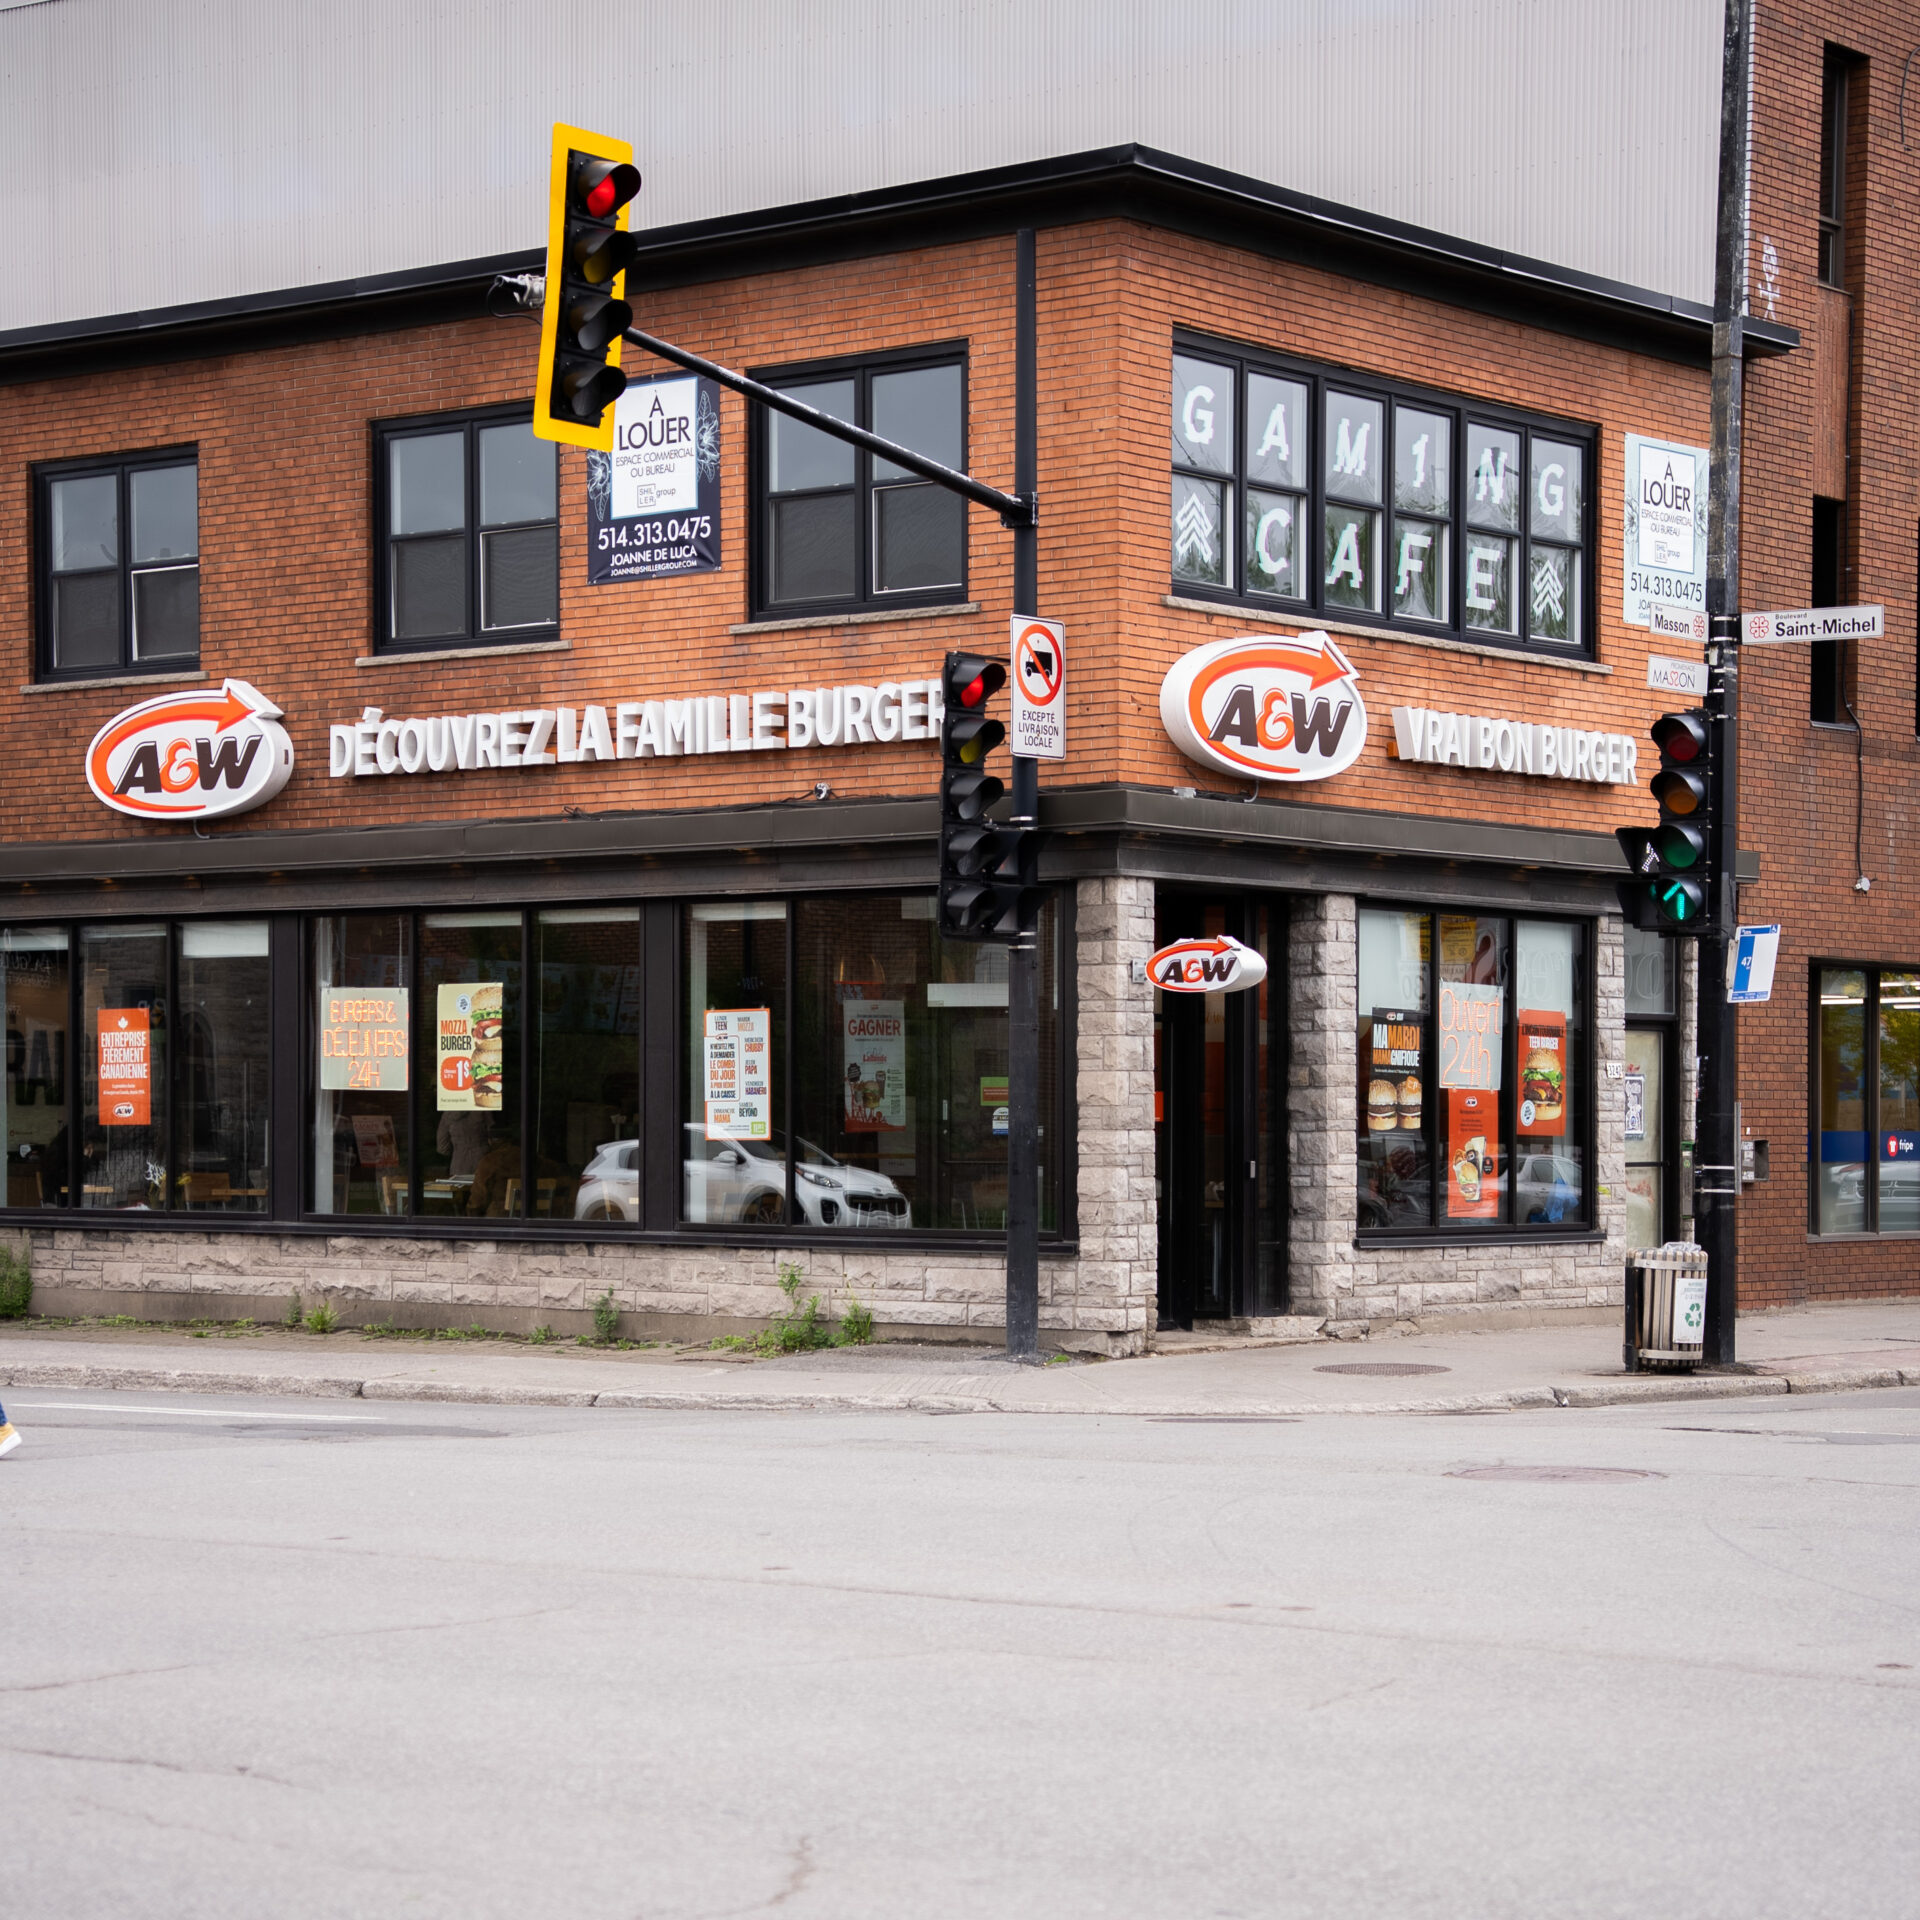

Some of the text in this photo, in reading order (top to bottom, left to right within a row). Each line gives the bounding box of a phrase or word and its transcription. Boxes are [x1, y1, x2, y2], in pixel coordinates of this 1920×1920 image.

[618, 416, 691, 450] LOUER
[615, 447, 695, 467] ESPACE COMMERCIAL
[630, 463, 676, 478] OU BUREAU
[655, 487, 677, 498] group
[1643, 479, 1691, 512] LOUER
[1641, 509, 1693, 527] ESPACE COMMERCIAL
[598, 516, 711, 551] 514.313.0475
[1650, 522, 1681, 537] OU BUREAU
[610, 545, 697, 567] JOANNE DE LUCA
[1255, 508, 1502, 612] CAFE
[1630, 572, 1703, 602] 514.313.0475
[1654, 613, 1690, 634] Masson
[1775, 612, 1808, 620] Boulevard
[1775, 616, 1875, 637] Saint-Michel
[1652, 669, 1696, 688] MASSON
[1022, 709, 1055, 724] EXCEPTÉ
[1207, 684, 1353, 757] A&W
[330, 678, 945, 777] DÉCOUVREZ LA FAMILLE BURGER
[1018, 722, 1059, 737] LIVRAISON
[1024, 735, 1053, 748] LOCALE
[1392, 706, 1639, 785] VRAI BON BURGER
[113, 734, 263, 795] A&W
[1158, 956, 1238, 984] A&W
[1741, 956, 1752, 967] 47
[1439, 988, 1501, 1035] Ouvert
[441, 1019, 467, 1035] MOZZA
[715, 1021, 728, 1031] TEEN
[847, 1019, 901, 1036] GAGNER
[101, 1031, 147, 1048] ENTREPRISE
[322, 1026, 406, 1057] DÉJEUNERS
[440, 1035, 472, 1051] BURGER
[710, 1060, 716, 1069] LE
[1441, 1034, 1491, 1087] 24h
[100, 1063, 148, 1079] CANADIENNE
[347, 1060, 381, 1088] 24H
[710, 1069, 736, 1080] DU JOUR
[738, 1107, 758, 1117] BEYOND
[1899, 1138, 1914, 1153] fripe
